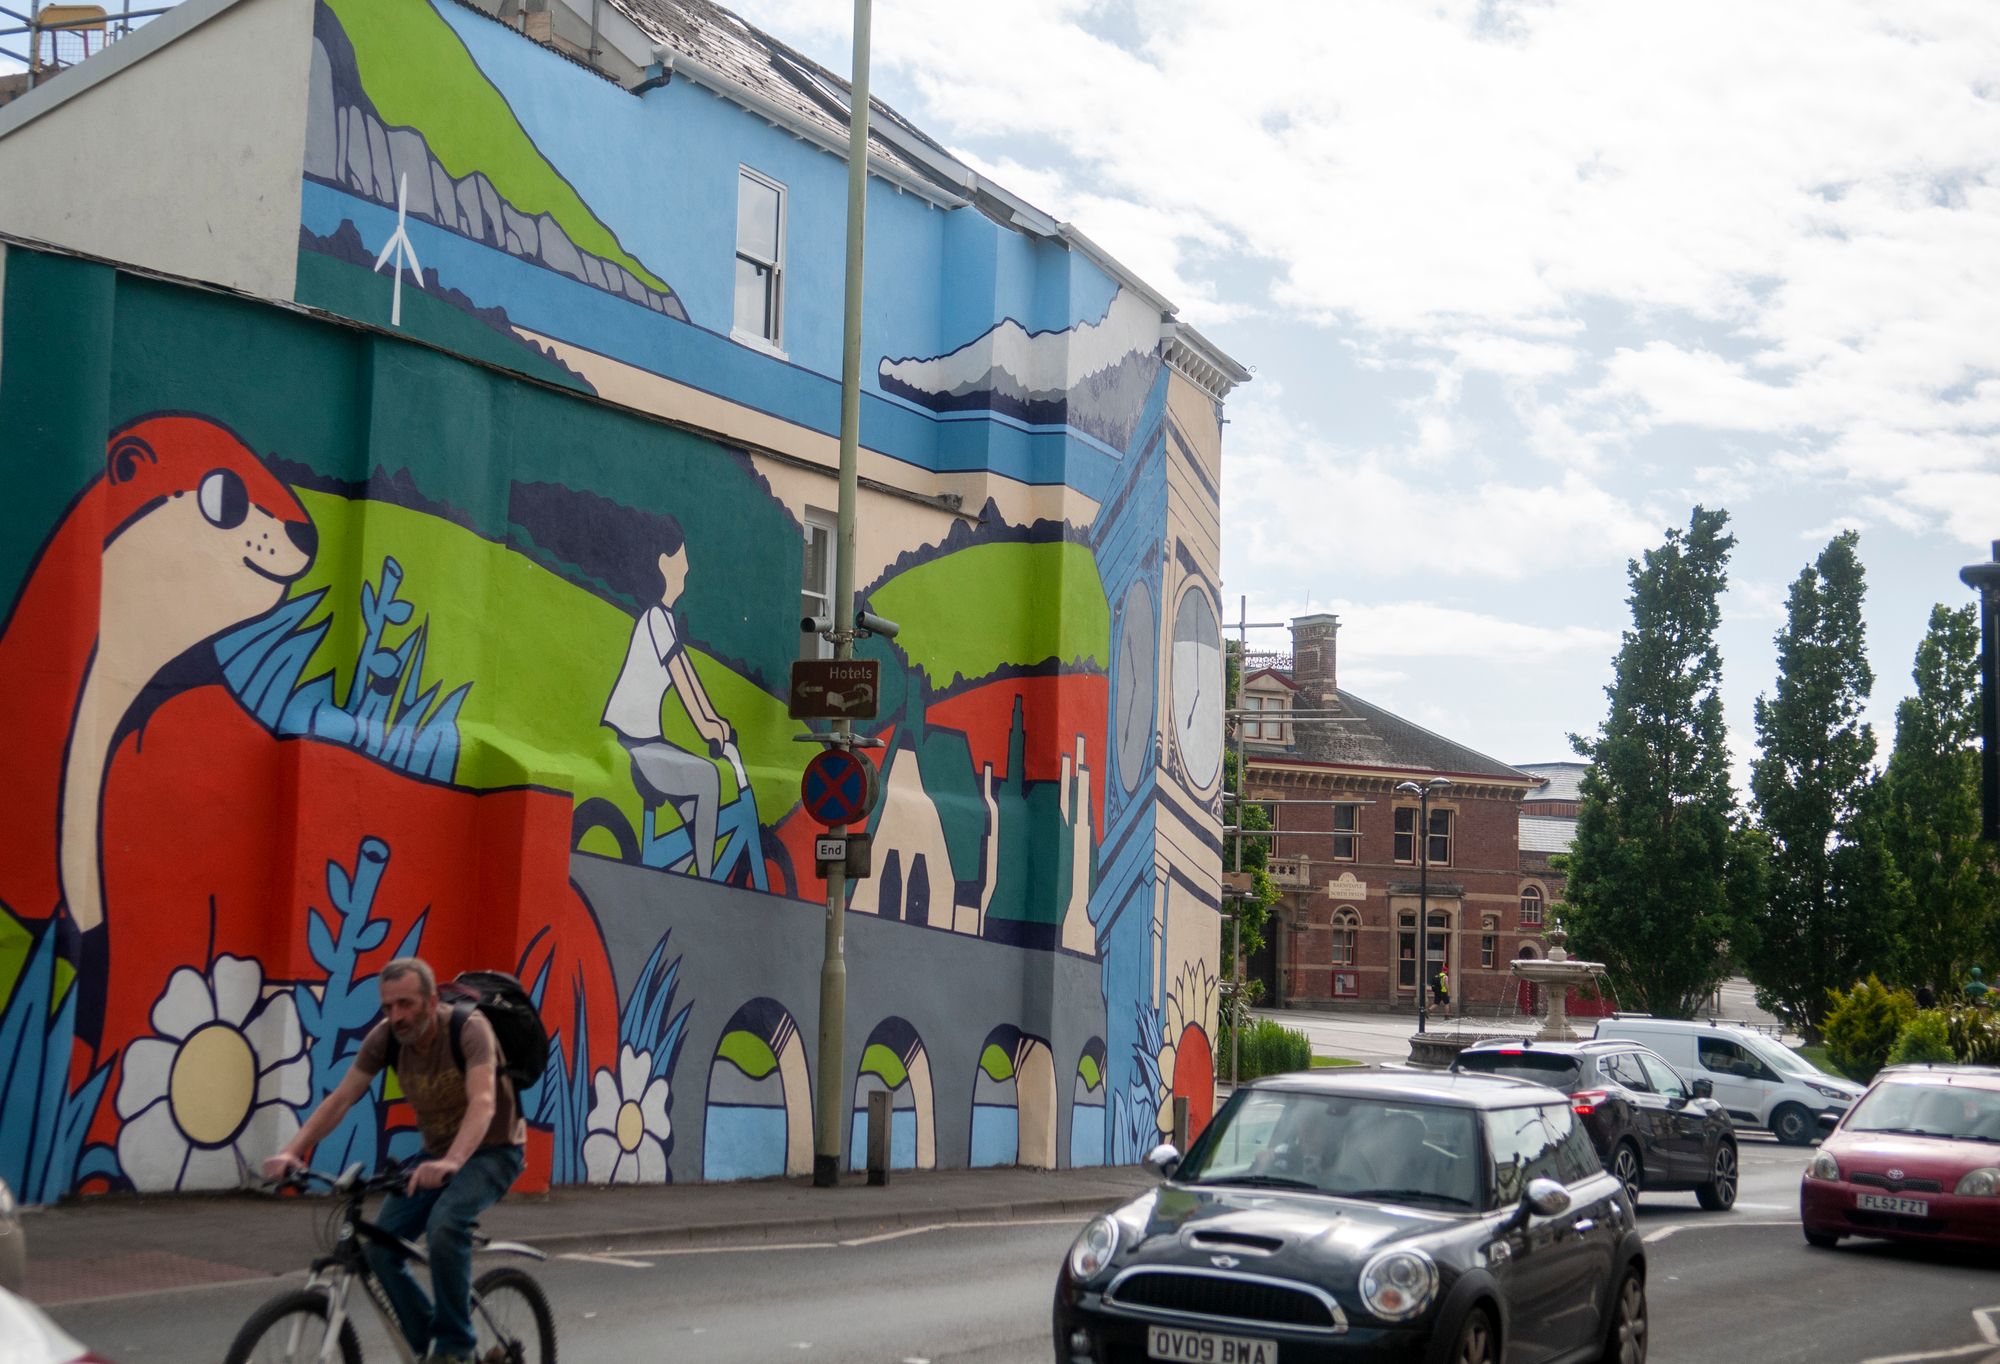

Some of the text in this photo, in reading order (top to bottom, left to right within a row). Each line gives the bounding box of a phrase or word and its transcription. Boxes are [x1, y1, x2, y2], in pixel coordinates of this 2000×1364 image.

[829, 666, 873, 680] Hotels
[821, 844, 842, 855] End
[1865, 1195, 1926, 1213] FL52 FZT
[1156, 1332, 1266, 1364] OV09 BWA
